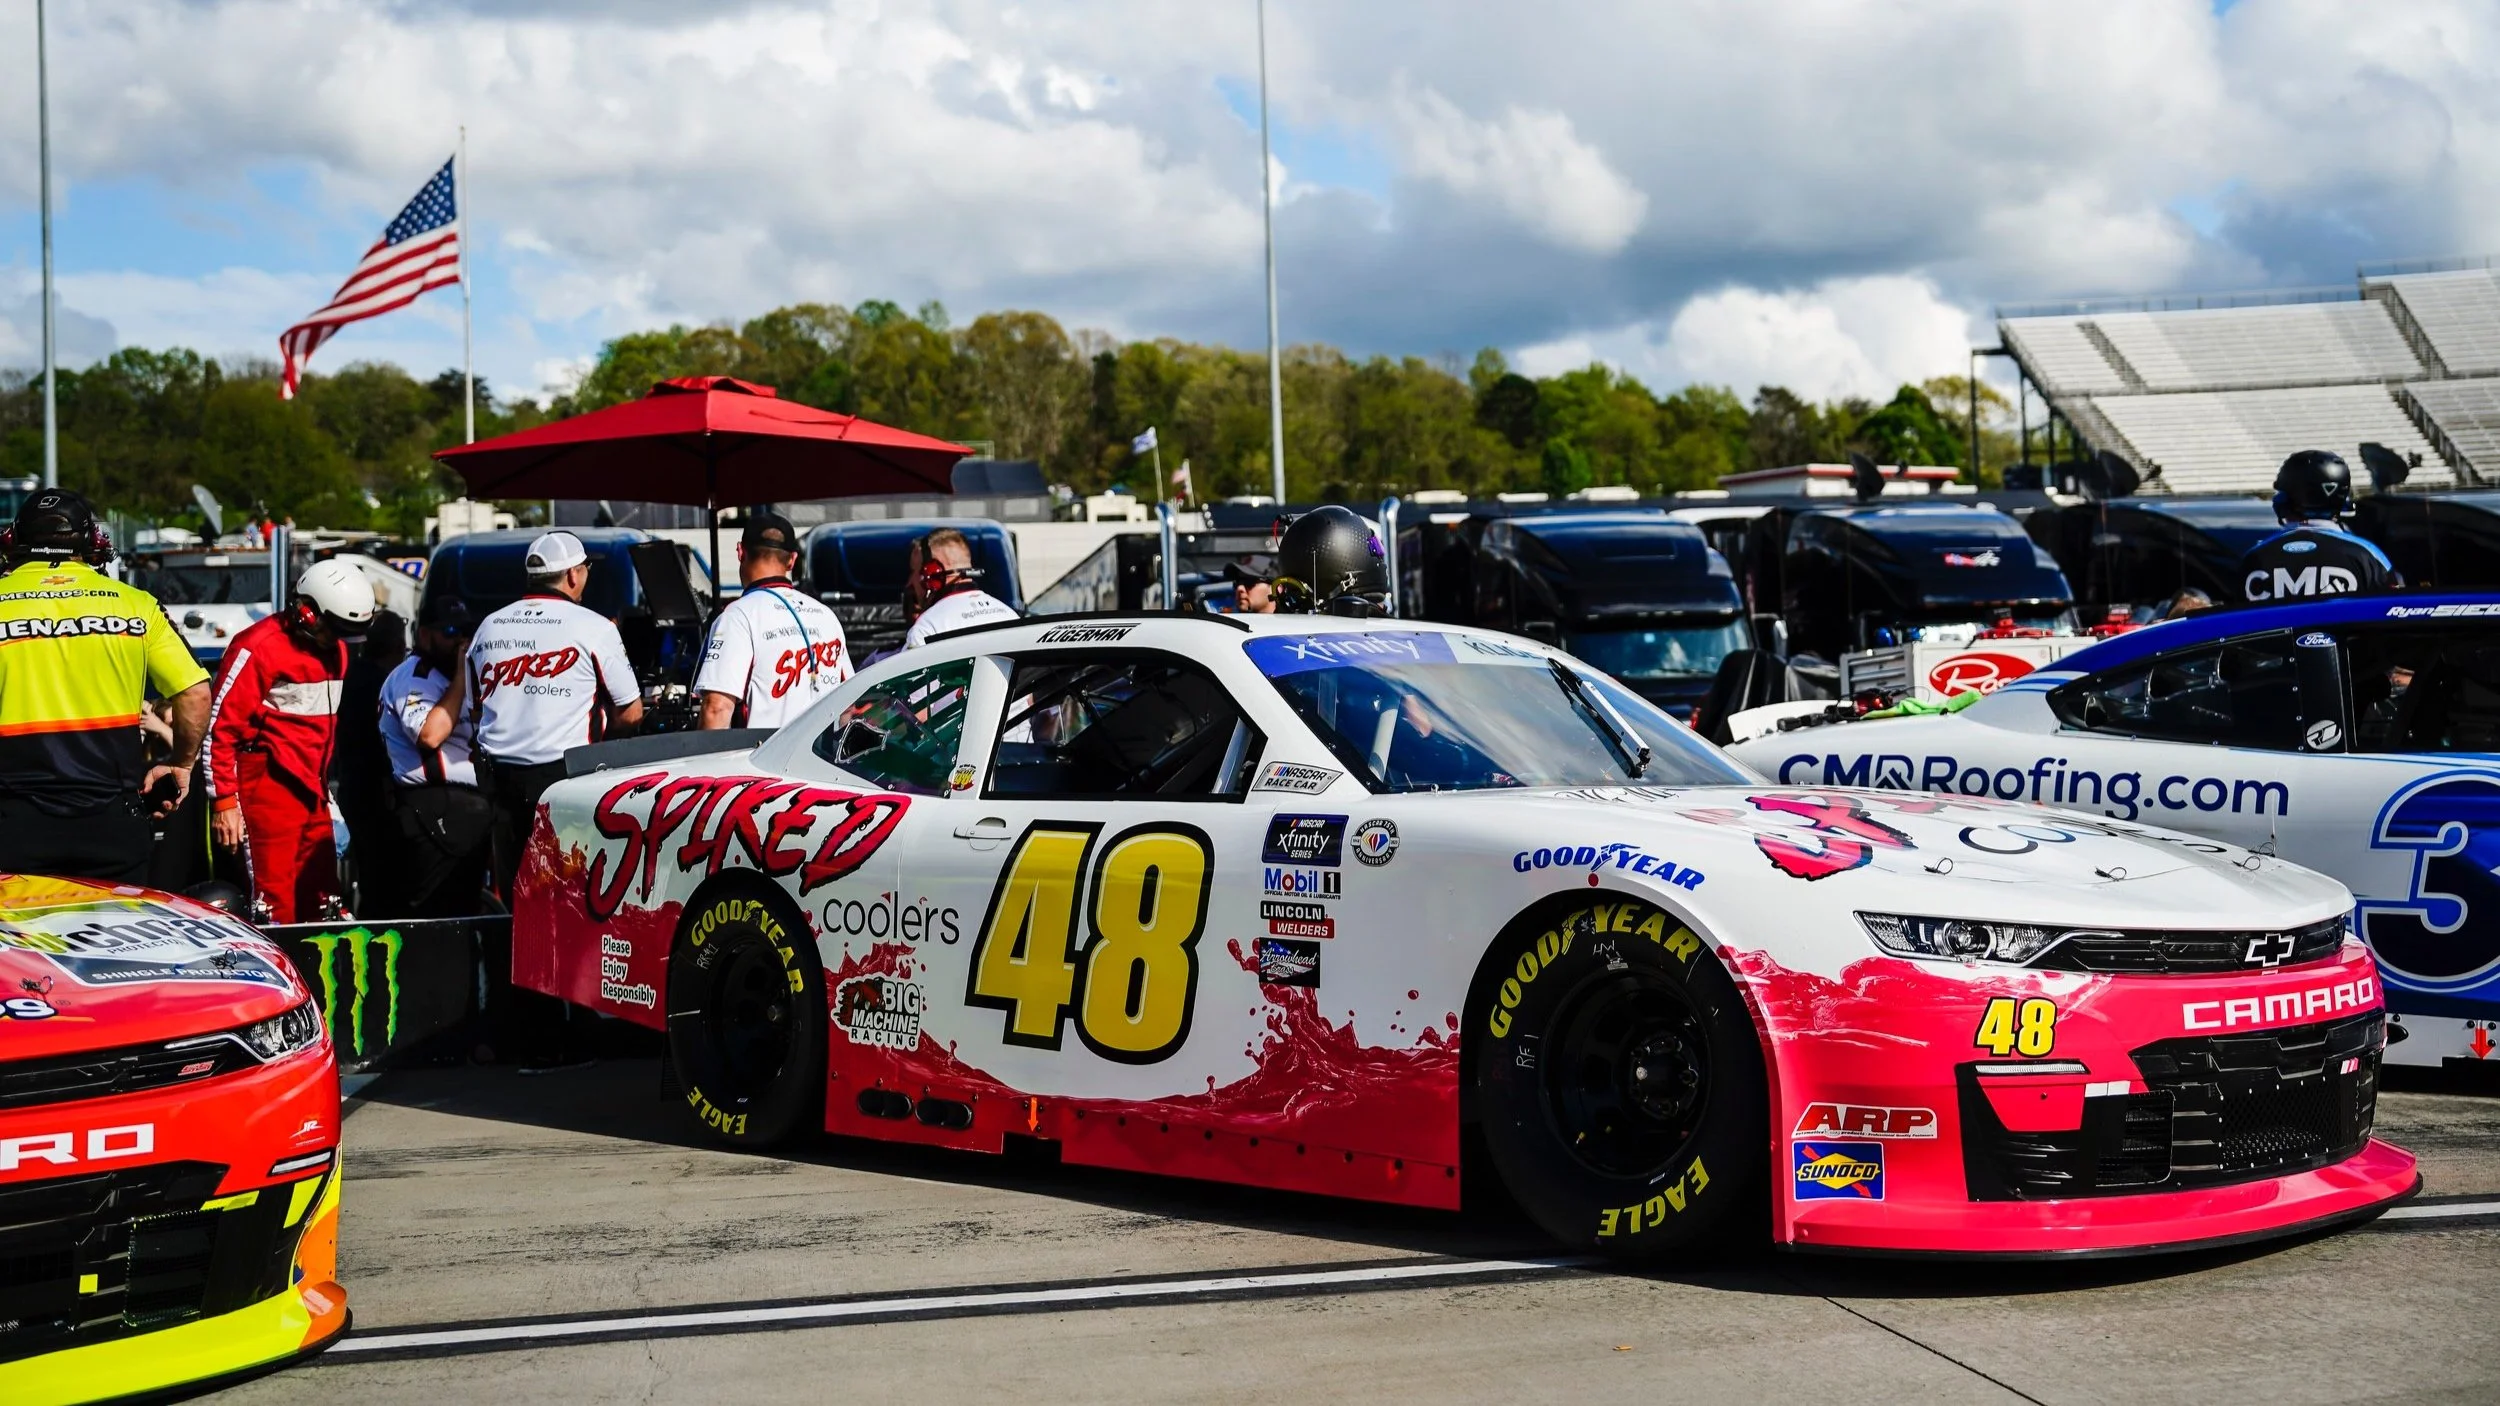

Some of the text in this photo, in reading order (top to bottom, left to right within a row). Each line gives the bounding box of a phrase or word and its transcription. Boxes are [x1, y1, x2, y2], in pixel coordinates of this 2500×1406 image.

[493, 617, 562, 625] @spikedcoolers
[2387, 606, 2434, 618] Ryan
[1036, 628, 1132, 643] KLIGERMAN
[2304, 634, 2331, 645] Ford
[1284, 636, 1420, 663] xfinity
[480, 646, 580, 700] SPIKED
[523, 683, 572, 697] coolers
[1264, 779, 1317, 790] RACE CAR
[1284, 766, 1327, 781] NASCAR
[1298, 819, 1325, 828] NASCAR
[586, 772, 911, 922] SPIKED
[1277, 828, 1330, 853] xfinity
[1290, 850, 1313, 859] SERIES
[1513, 843, 1705, 891] GOODYEAR
[1264, 867, 1318, 892] Mobil
[823, 889, 960, 945] coolers
[1263, 904, 1322, 920] LINCOLN
[964, 819, 1215, 1065] 48
[1277, 923, 1328, 936] WELDERS
[603, 937, 630, 954] Please
[692, 899, 804, 995] GOODYEAR
[1260, 947, 1316, 968] Arrowhead
[92, 967, 175, 981] SHINGLE
[603, 959, 627, 980] Enjoy
[1489, 903, 1700, 1039] GOODYEAR
[603, 981, 655, 1007] Responsibly
[882, 981, 920, 1015] BIG
[2183, 977, 2375, 1031] CAMARO
[850, 1008, 919, 1035] MACHINE
[1974, 997, 2057, 1058] 48
[851, 1028, 916, 1047] RACING
[687, 1086, 747, 1135] EAGLE
[1797, 1105, 1934, 1134] ARP
[1800, 1164, 1877, 1179] SUNOCO
[1598, 1155, 1710, 1237] EAGLE
